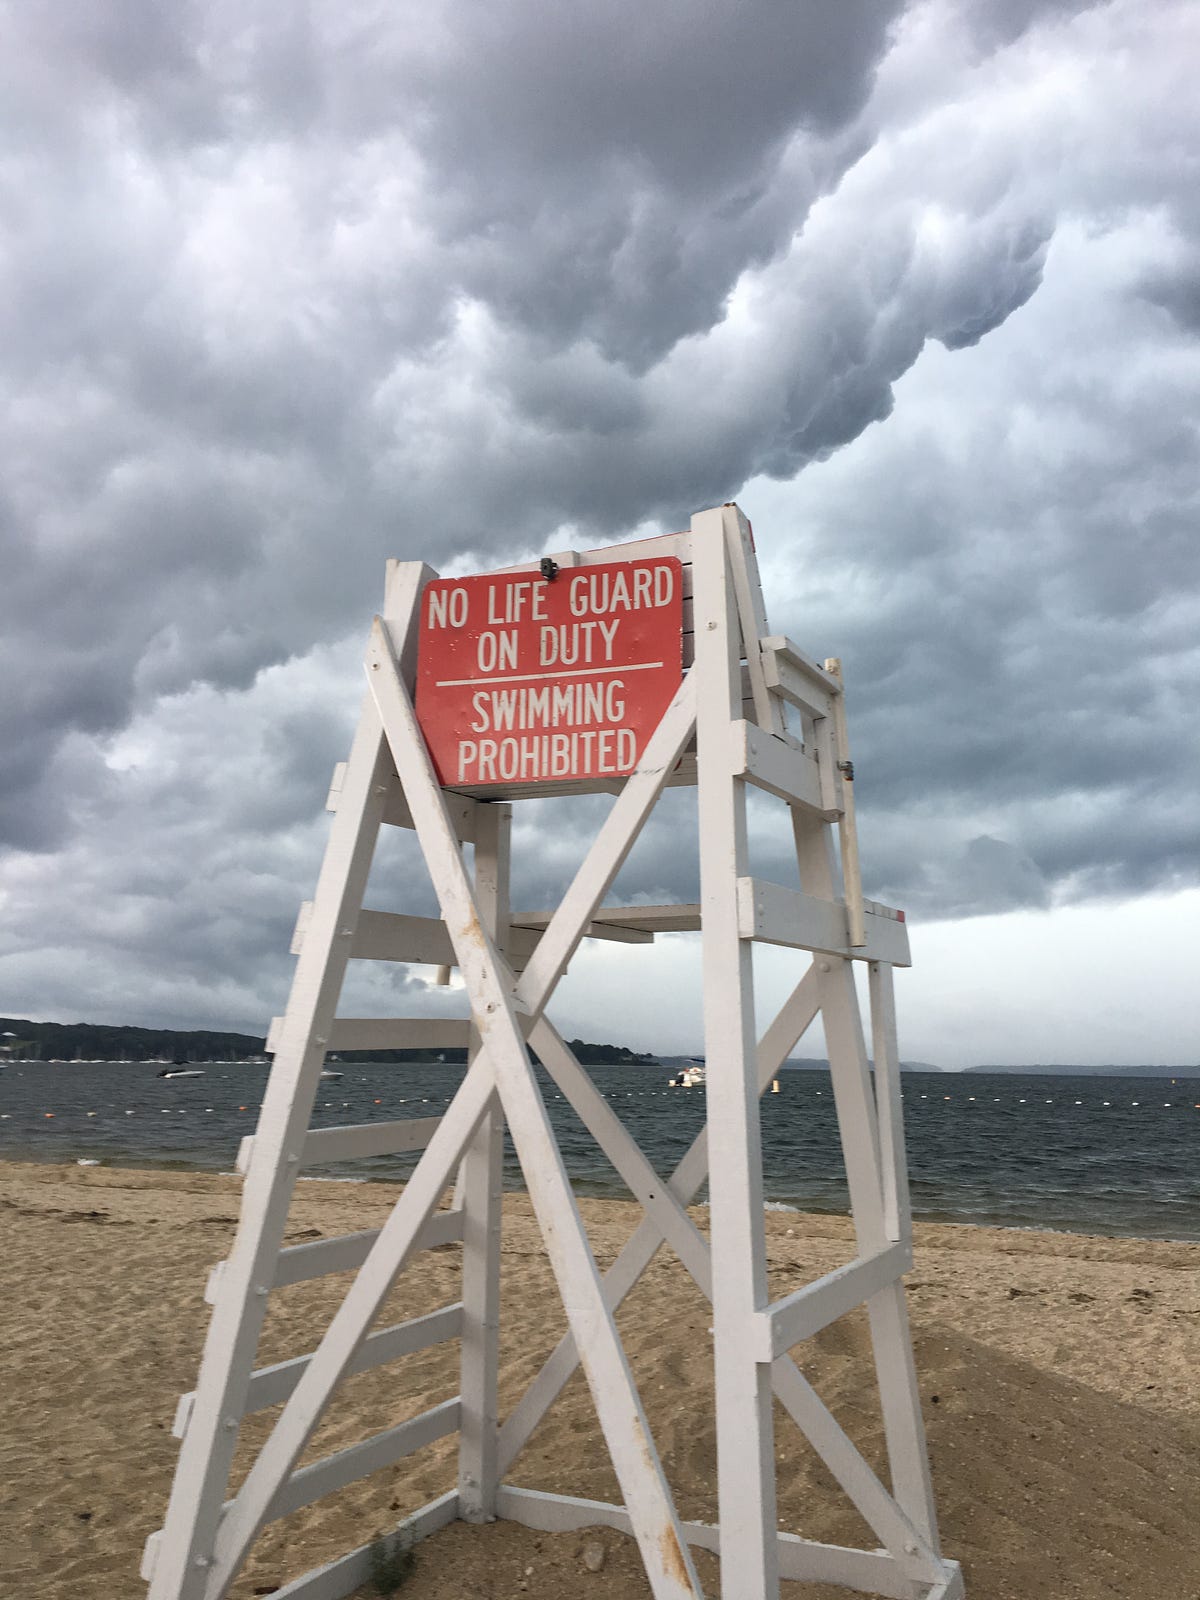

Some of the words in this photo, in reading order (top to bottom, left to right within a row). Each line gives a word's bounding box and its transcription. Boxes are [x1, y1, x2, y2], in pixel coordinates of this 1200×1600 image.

[428, 588, 468, 629] NO
[488, 581, 548, 624] LIFE
[570, 566, 673, 617] GUARD
[477, 630, 518, 672] ON
[540, 619, 620, 666] DUTY
[471, 680, 625, 733] SWIMMING
[458, 729, 637, 782] PROHIBITED
